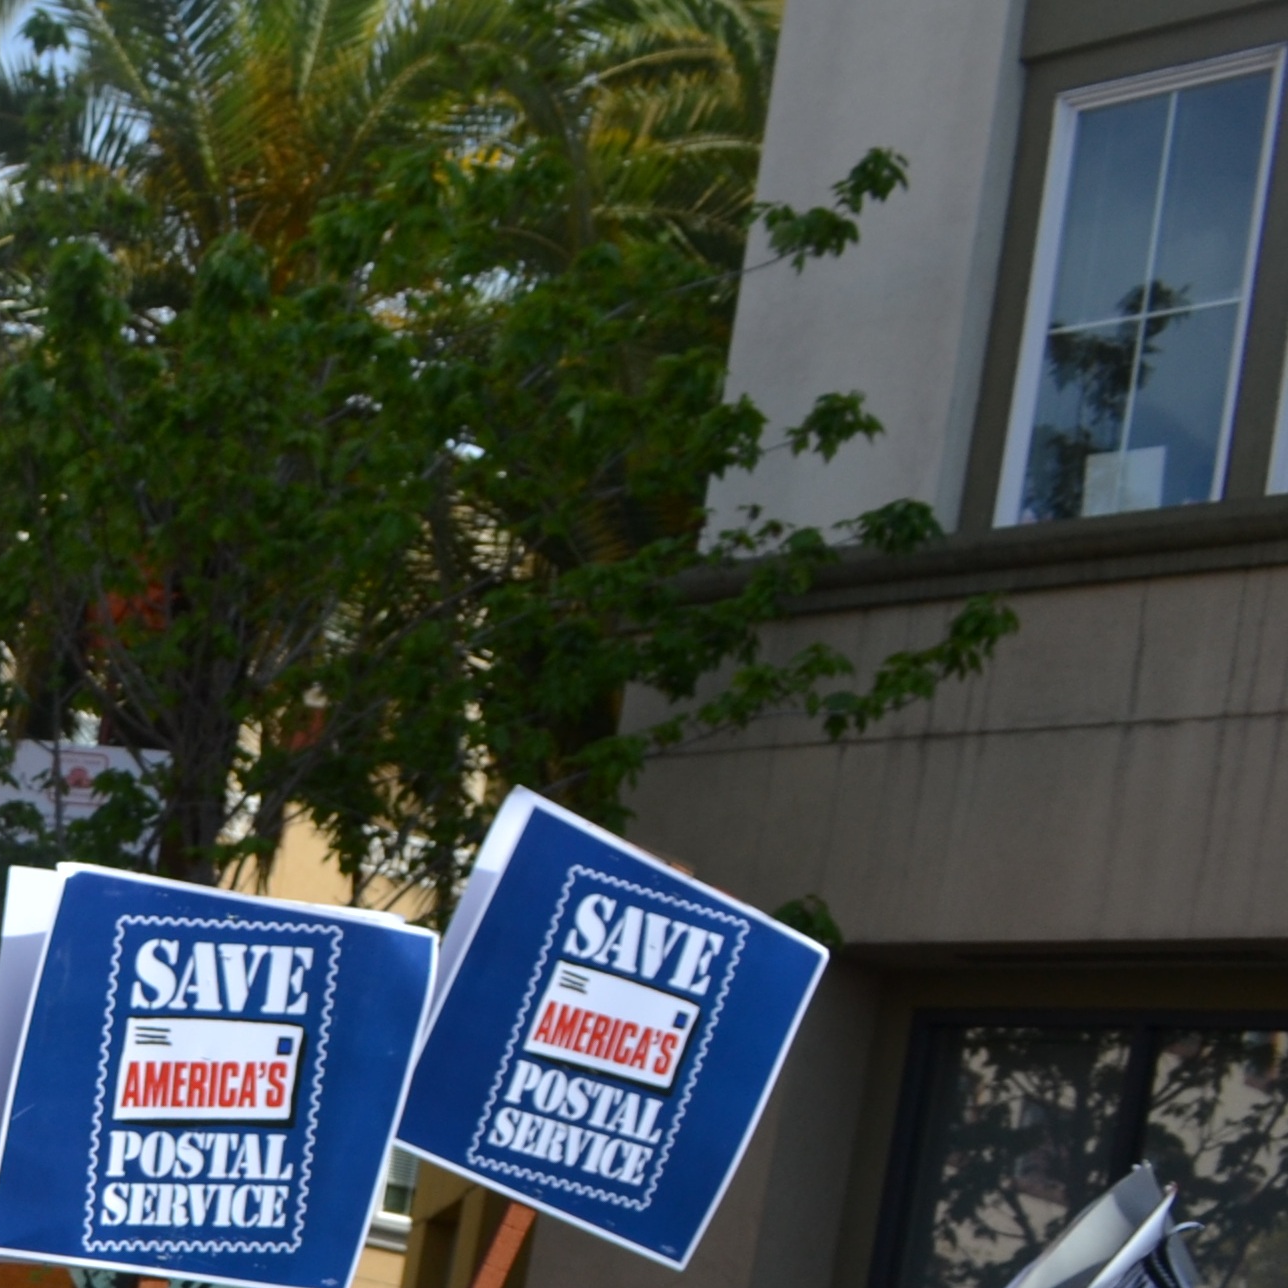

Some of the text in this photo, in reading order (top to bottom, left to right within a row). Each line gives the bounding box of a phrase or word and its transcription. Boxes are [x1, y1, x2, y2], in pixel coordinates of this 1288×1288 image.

[130, 939, 315, 1015] SAVE
[563, 892, 724, 996] SAVE
[533, 1001, 679, 1076] AMERICA'S
[121, 1061, 289, 1109] AMERICA'S
[505, 1059, 664, 1144] POSTAL
[106, 1130, 293, 1181] POSTAL
[488, 1107, 654, 1187] SERVICE
[100, 1182, 290, 1229] SERVICE
